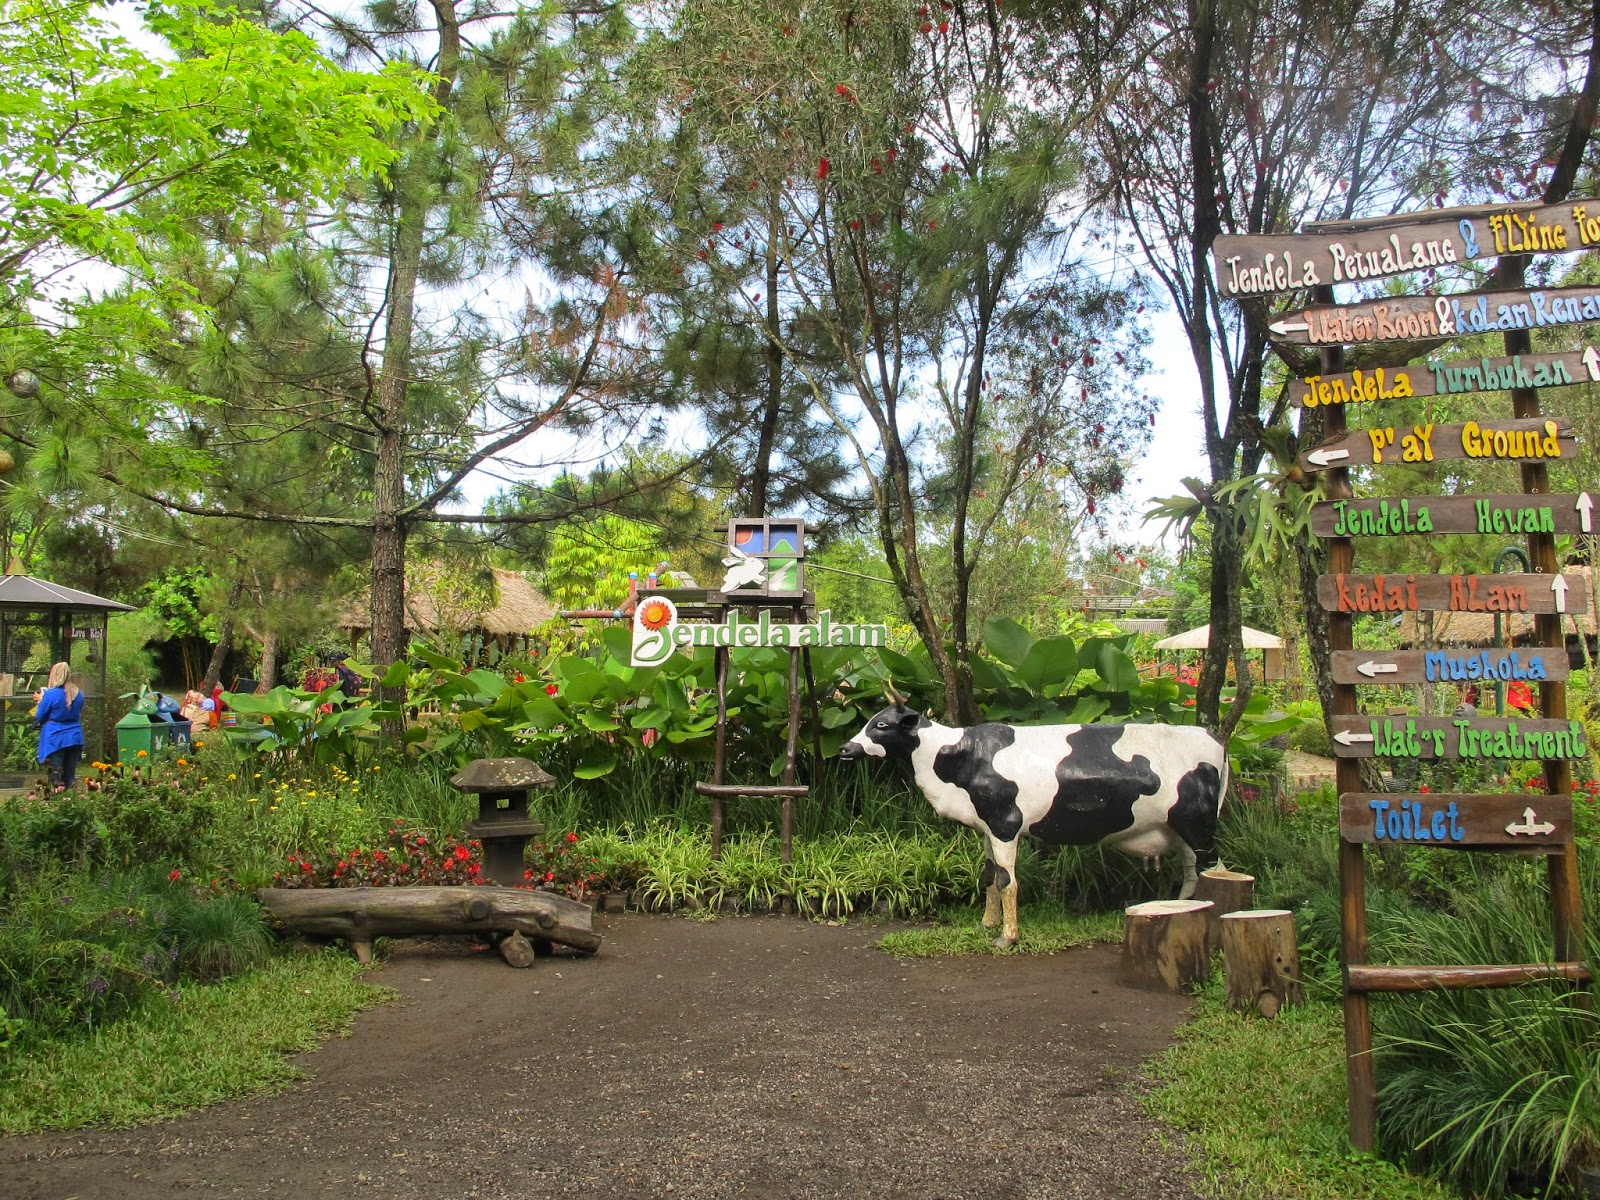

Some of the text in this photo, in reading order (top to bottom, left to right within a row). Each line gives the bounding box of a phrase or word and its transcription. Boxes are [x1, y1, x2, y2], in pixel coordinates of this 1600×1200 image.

[1458, 219, 1479, 259] &
[1435, 296, 1455, 335] &
[1429, 355, 1573, 394] Tumbuhan
[1462, 421, 1561, 458] Ground
[1475, 499, 1555, 533] Hewan
[799, 609, 886, 647] alam
[1454, 719, 1586, 758] Treatment
